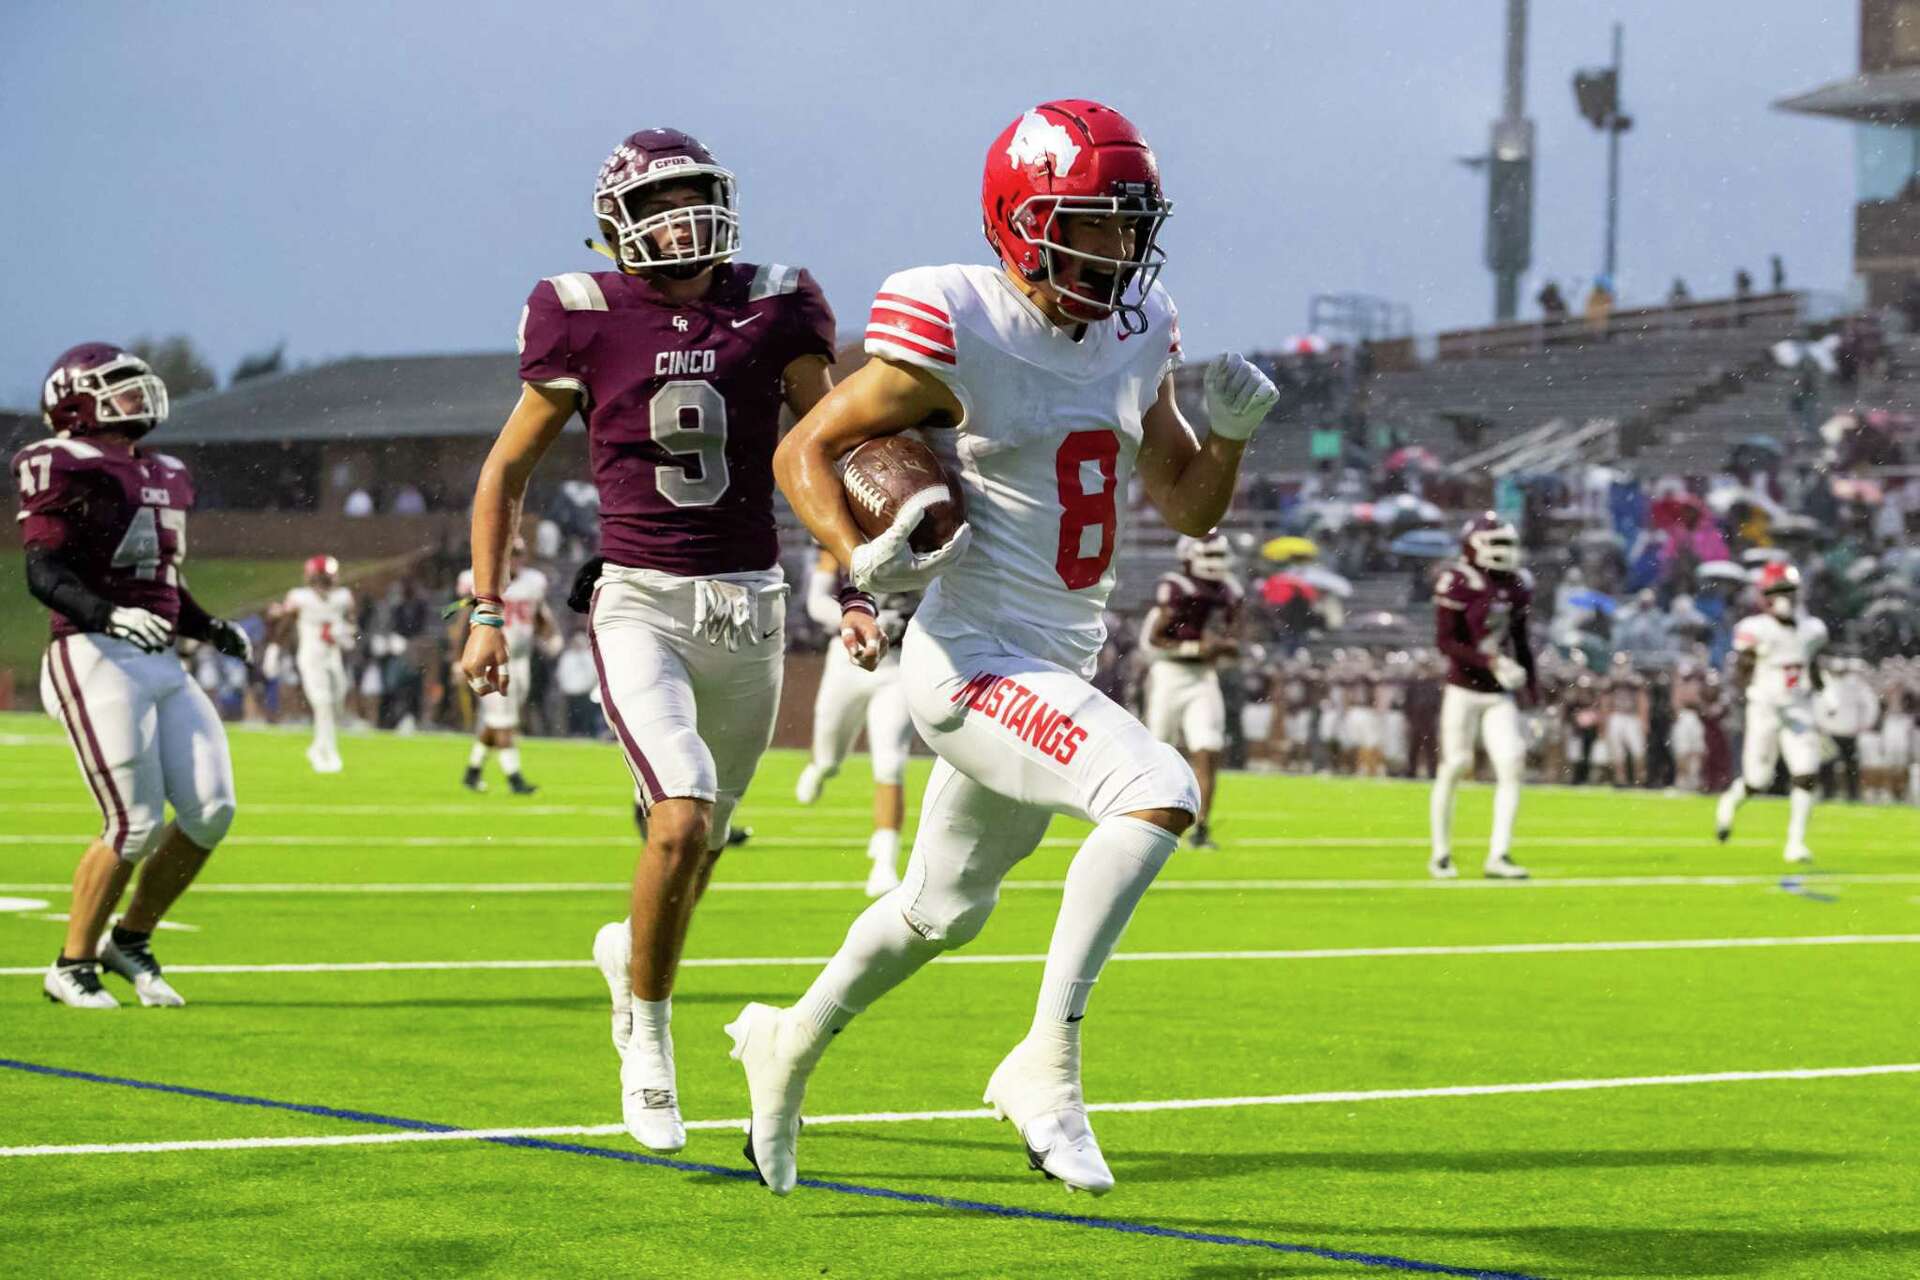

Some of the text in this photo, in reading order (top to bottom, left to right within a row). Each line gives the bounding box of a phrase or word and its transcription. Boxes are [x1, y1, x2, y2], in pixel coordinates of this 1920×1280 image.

[655, 350, 717, 375] CINCO
[650, 380, 731, 508] 9
[111, 506, 187, 588] 47
[1056, 429, 1120, 590] 8
[950, 670, 1088, 766] MUSTANGS
